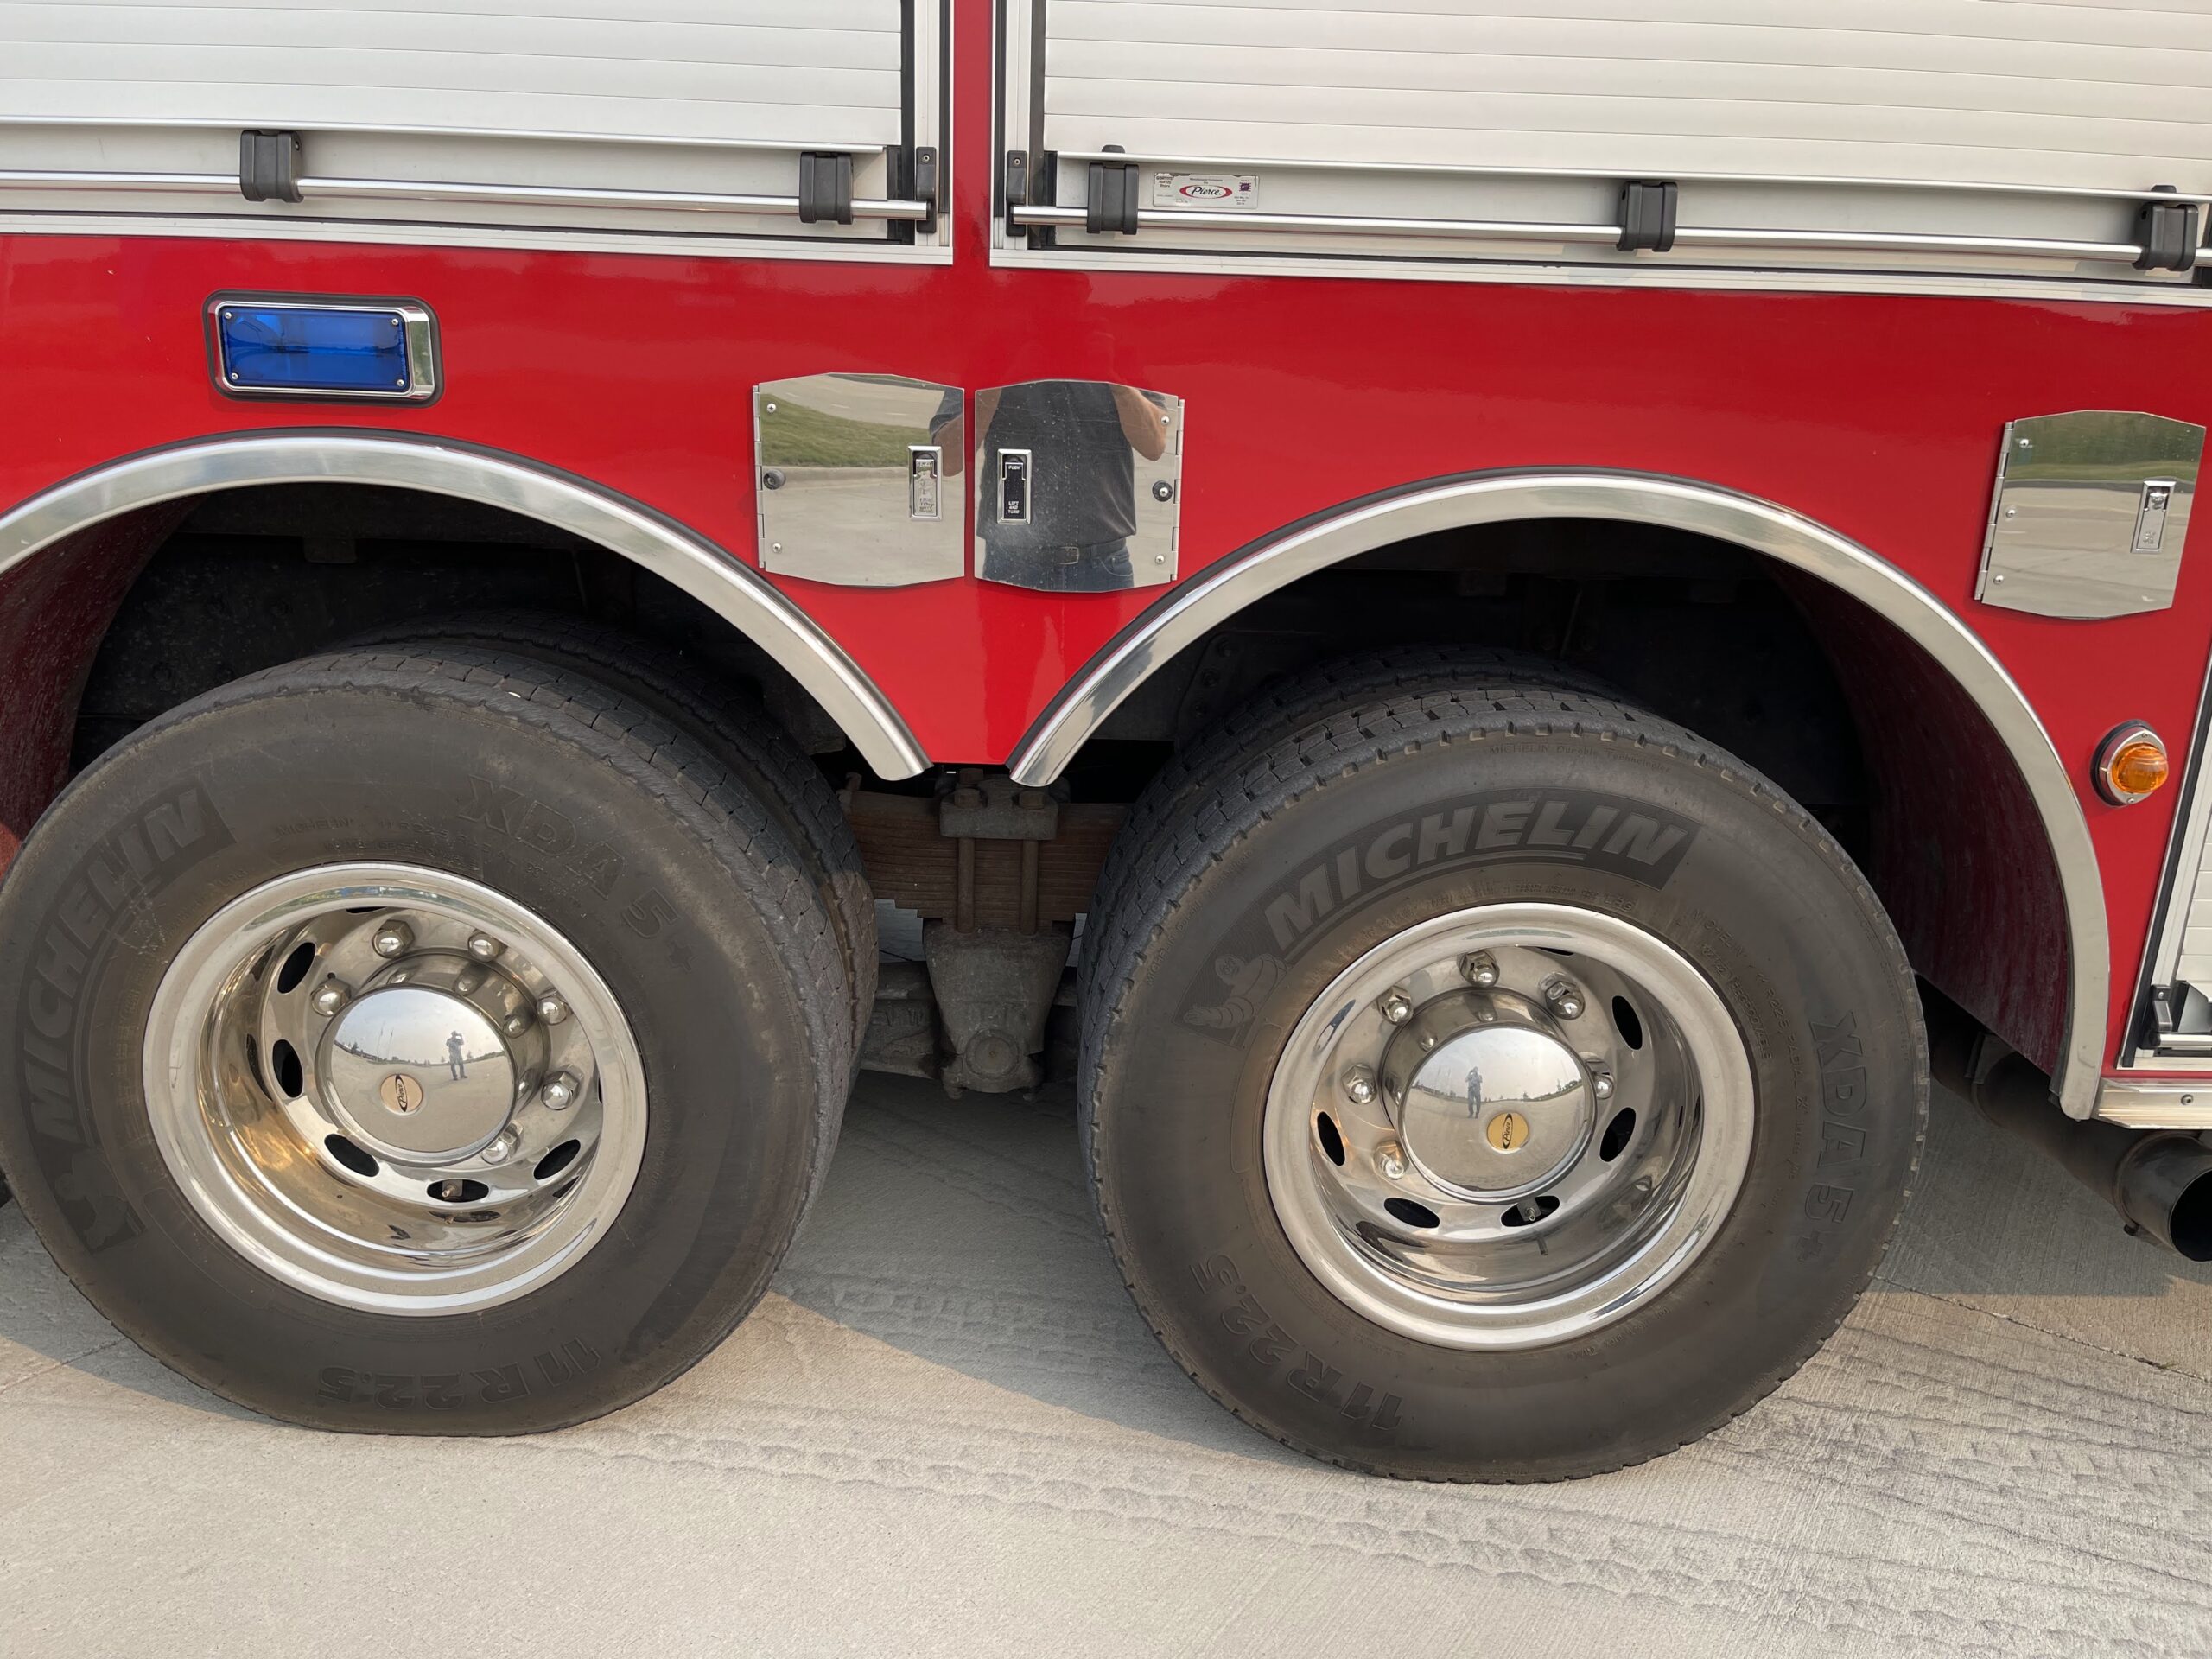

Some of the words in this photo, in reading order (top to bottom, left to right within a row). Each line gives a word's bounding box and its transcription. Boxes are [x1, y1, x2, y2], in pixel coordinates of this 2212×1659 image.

[1191, 186, 1221, 195] Pierce
[1265, 800, 1689, 950] MICHELIN
[23, 787, 205, 1145] MICHELIN
[1808, 1009, 1868, 1169] XDA
